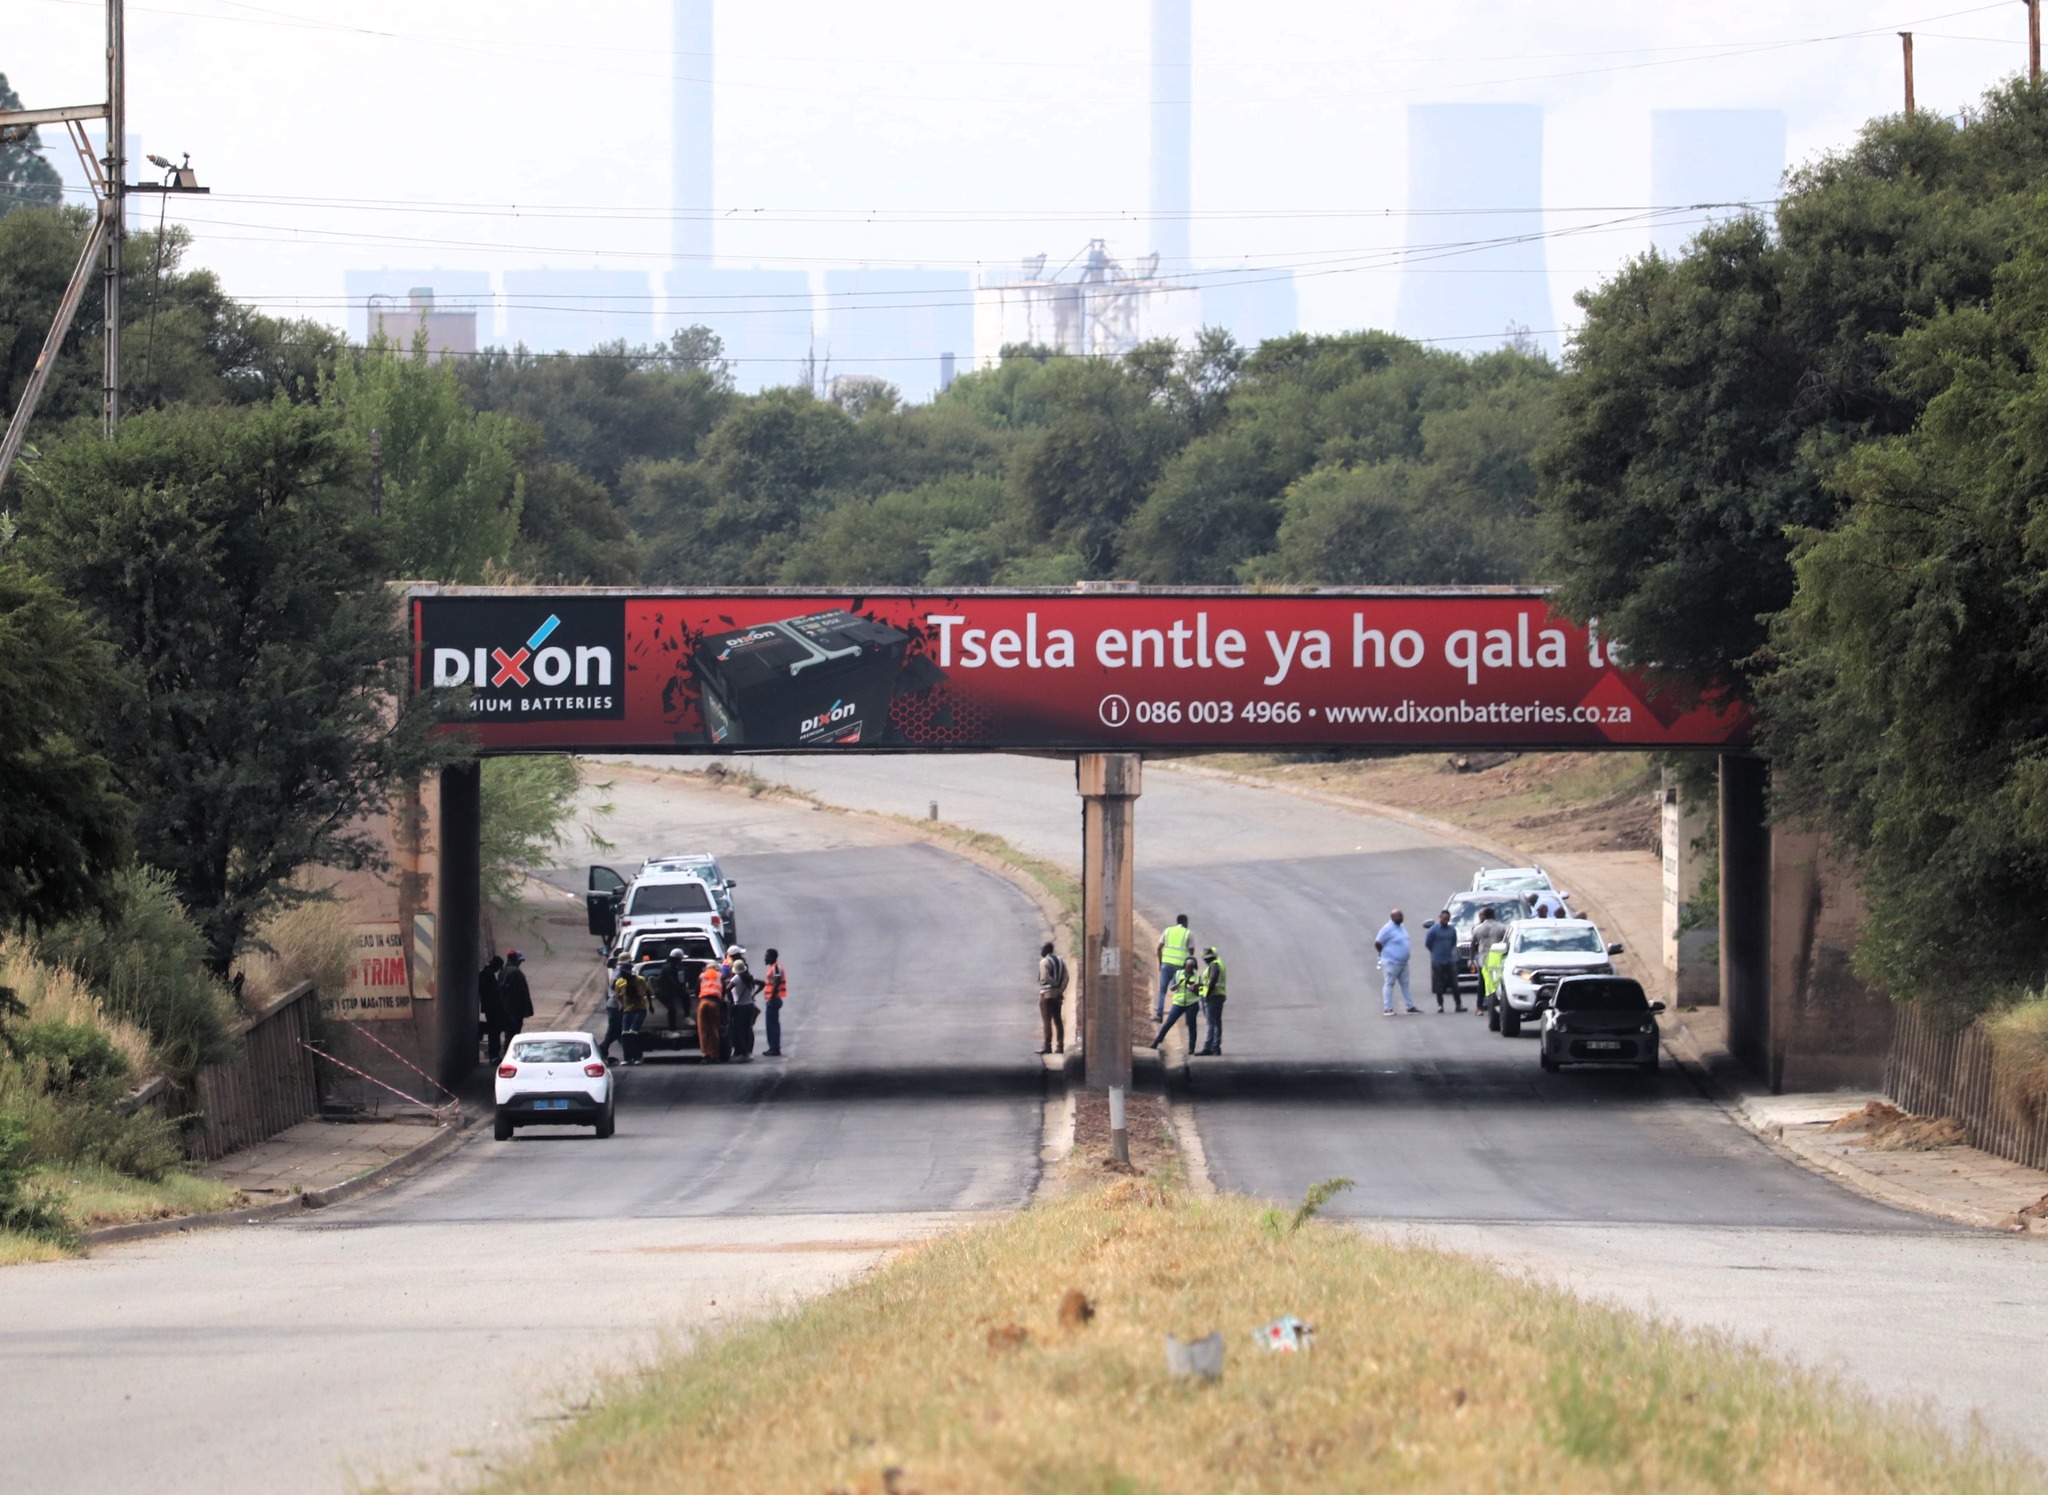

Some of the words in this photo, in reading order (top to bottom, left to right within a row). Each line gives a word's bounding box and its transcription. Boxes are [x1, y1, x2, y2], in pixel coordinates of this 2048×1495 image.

[927, 612, 1075, 669] Tsela
[1095, 612, 1247, 669] entle
[1263, 629, 1331, 686] ya
[1352, 612, 1425, 668] ho
[1444, 612, 1566, 685] qala
[520, 696, 612, 711] BATTERIES
[1135, 700, 1182, 724] 086
[1188, 700, 1234, 724] 003
[1240, 700, 1301, 724] 4966
[1325, 699, 1632, 724] www.dixonbatteries.co.za
[361, 957, 405, 986] TRIM
